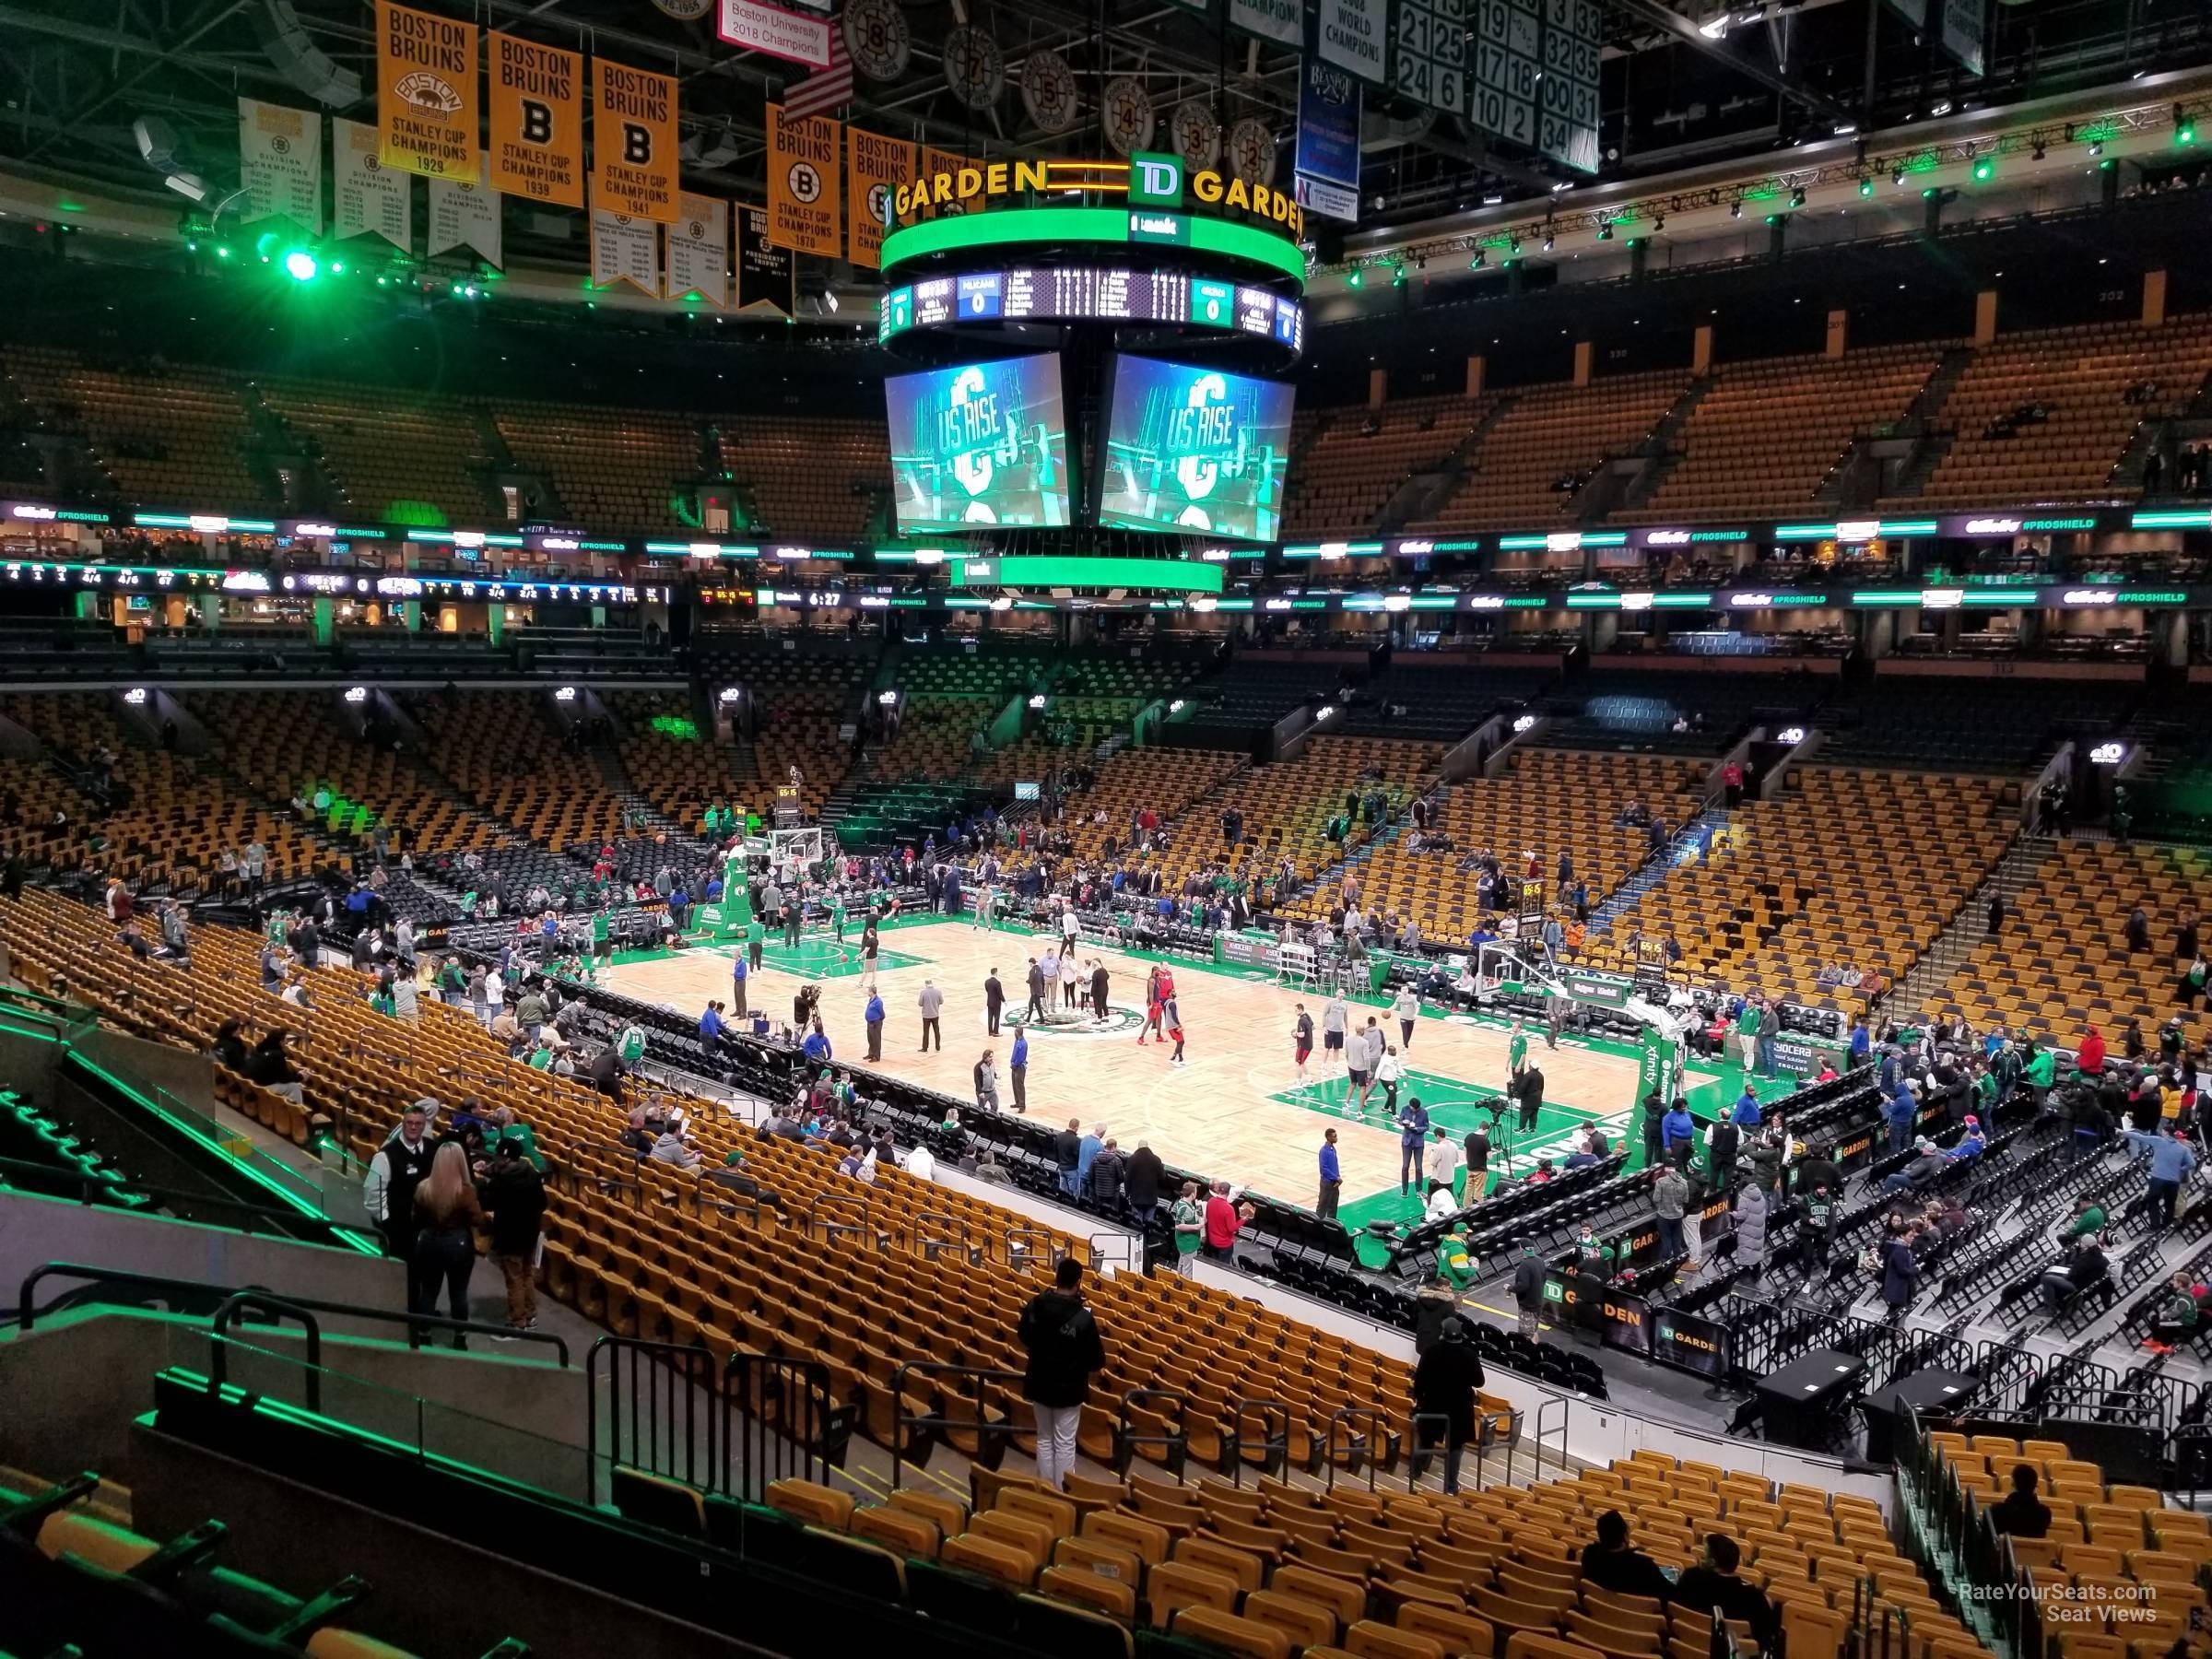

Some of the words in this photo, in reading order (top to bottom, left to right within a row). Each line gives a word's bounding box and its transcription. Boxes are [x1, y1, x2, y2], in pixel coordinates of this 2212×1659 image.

[390, 9, 465, 49] BOSTON
[732, 5, 768, 25] Boston
[771, 15, 819, 41] University
[1337, 7, 1371, 36] WORLD
[1402, 8, 1428, 51] 21
[1483, 3, 1505, 38] 19
[1577, 4, 1600, 41] 33
[733, 22, 759, 39] 2018
[762, 29, 819, 56] Champions
[870, 24, 884, 46] 8
[1326, 24, 1379, 63] CHAMPIONS
[1435, 22, 1464, 64] 25
[390, 33, 465, 74] BRUINS
[500, 39, 571, 78] BOSTON
[1547, 32, 1572, 70] 32
[1575, 44, 1599, 81] 35
[969, 57, 981, 78] 7
[1399, 56, 1427, 99] 24
[1478, 46, 1503, 88] 17
[1511, 58, 1533, 97] 18
[397, 74, 462, 109] BOSTON
[501, 63, 571, 101] BRUINS
[604, 65, 667, 100] BOSTON
[1043, 82, 1055, 103] 5
[1441, 72, 1454, 107] 6
[1545, 77, 1569, 112] 00
[605, 88, 668, 124] BRUINS
[1123, 108, 1134, 128] 4
[1478, 89, 1500, 128] 10
[1576, 88, 1595, 124] 31
[393, 116, 441, 140] STANLEY
[444, 128, 465, 146] CUP
[520, 96, 553, 147] B
[1513, 106, 1525, 139] 2
[392, 133, 467, 161] CHAMPIONS
[621, 118, 653, 168] B
[777, 131, 831, 163] BRUINS
[856, 134, 907, 163] BOSTON
[1190, 130, 1199, 149] 3
[1543, 118, 1567, 154] 34
[254, 160, 308, 177] CHAMPIONS
[259, 153, 301, 166] DIVISION
[417, 155, 444, 174] 1929
[502, 143, 547, 168] STANLEY
[551, 156, 570, 170] CUP
[857, 154, 907, 183] BRUINS
[1249, 147, 1258, 165] 2
[353, 171, 392, 183] DIVISION
[501, 159, 571, 185] CHAMPIONS
[606, 165, 646, 186] STANLEY
[650, 175, 667, 189] CUP
[1136, 160, 1178, 195] TD
[347, 178, 398, 194] CHAMPIONS
[448, 192, 484, 204] DIVISION
[524, 180, 550, 196] 1939
[606, 180, 669, 205] CHAMPIONS
[896, 160, 1047, 216] GARDEN
[441, 197, 488, 212] CHAMPIONS
[627, 199, 650, 215] 1941
[778, 202, 813, 221] STANLEY
[816, 210, 831, 223] CUP
[1194, 171, 1304, 238] GARDEN
[777, 218, 832, 239] CHAMPIONS
[795, 234, 816, 249] 1970
[858, 223, 884, 240] STANL
[972, 292, 984, 313] 0
[2100, 290, 2124, 302] 302
[1206, 300, 1219, 321] 0
[937, 406, 964, 453] US
[964, 393, 1002, 444] RISE
[1167, 407, 1196, 452] US
[1198, 406, 1234, 450] RISE
[1691, 531, 1747, 542] #PROSHIELD
[2022, 519, 2095, 531] #PROSHIELD
[1433, 542, 1478, 552] #PROSHIELD
[82, 572, 101, 583] 4/4
[809, 594, 841, 606] 6:27
[1504, 598, 1547, 606] #PROSHIELD
[1773, 594, 1827, 605] #PROSHIELD
[2117, 593, 2186, 603] #PROSHIELD
[2102, 743, 2123, 758] 10
[779, 788, 797, 797] 65:15
[1524, 884, 1541, 896] 65:15
[1229, 942, 1253, 952] KYOCERA
[1641, 941, 1662, 953] 65:15
[1522, 985, 1546, 995] xfinity
[1774, 1041, 1812, 1057] YOCERA
[1644, 1044, 1659, 1085] xfinity
[1778, 1062, 1808, 1072] ENGLAND
[1660, 1071, 1670, 1104] Putnam
[1843, 1137, 1870, 1158] GARDEN
[1816, 1216, 1826, 1226] 11
[1547, 1282, 1561, 1299] TD
[1565, 1290, 1641, 1327] GDEN
[1663, 1327, 1674, 1338] TD
[1675, 1333, 1718, 1353] GARDE
